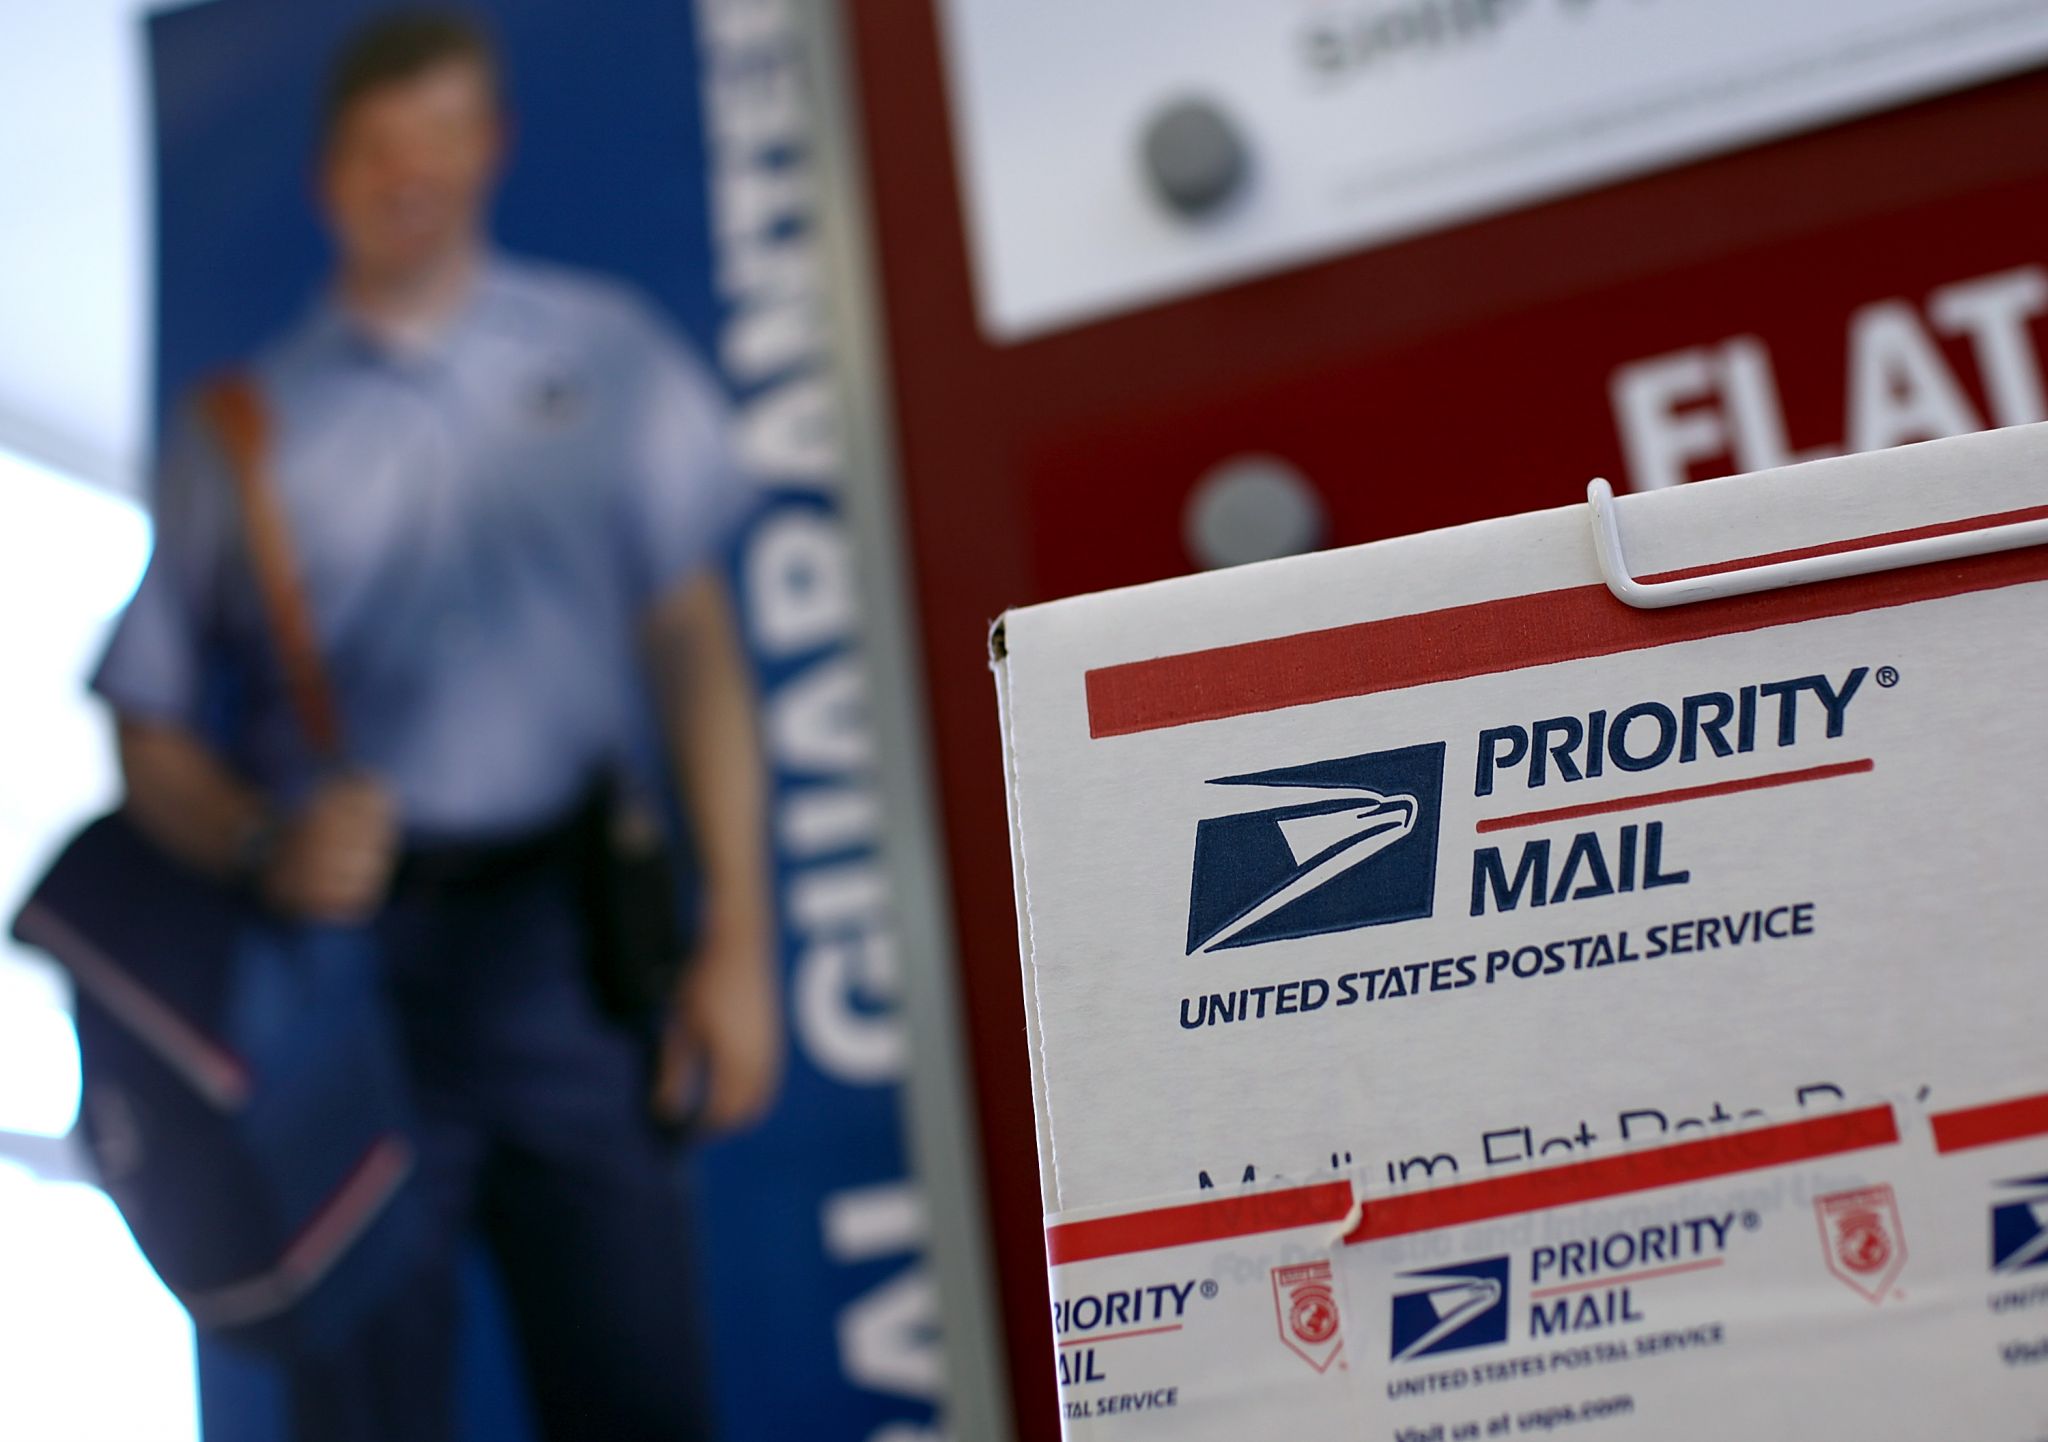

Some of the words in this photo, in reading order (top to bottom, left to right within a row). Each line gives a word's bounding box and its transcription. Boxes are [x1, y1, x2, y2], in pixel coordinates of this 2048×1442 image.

[1469, 821, 1691, 917] MAIL
[1179, 977, 1330, 1030] UNITED
[1336, 955, 1478, 1007] STATES
[1485, 931, 1640, 984] POSTAL
[1645, 901, 1815, 960] SERVICE
[1530, 1287, 1644, 1340] MAIL
[1386, 1366, 1469, 1402] UNITED
[1472, 1352, 1546, 1387] STATES
[1550, 1340, 1630, 1373] POSTAL
[1634, 1321, 1726, 1356] SERVICE
[1096, 1385, 1179, 1417] SERVICE
[1451, 1421, 1481, 1441] us
[1487, 1413, 1511, 1435] at
